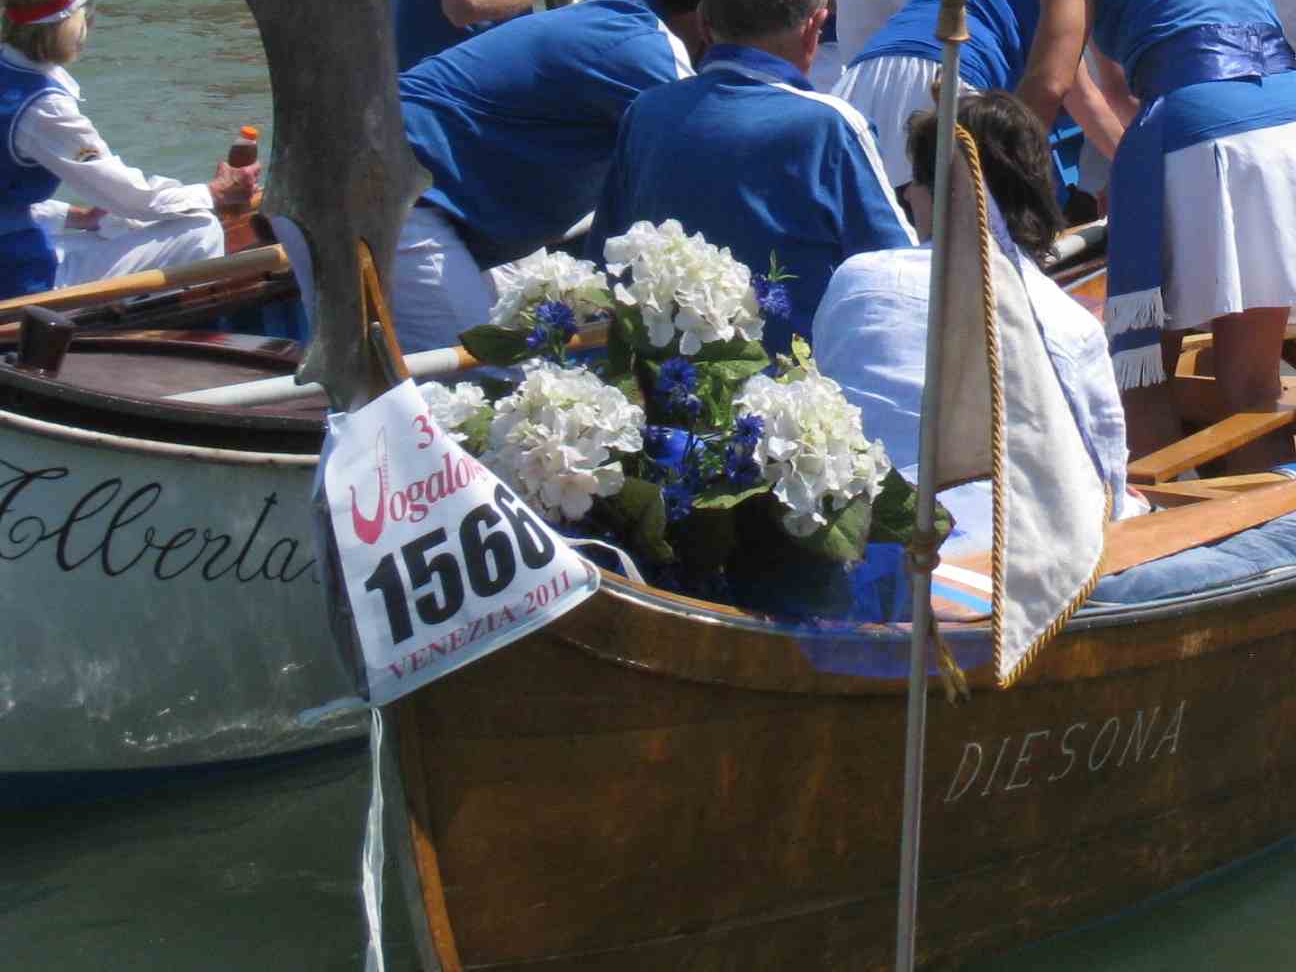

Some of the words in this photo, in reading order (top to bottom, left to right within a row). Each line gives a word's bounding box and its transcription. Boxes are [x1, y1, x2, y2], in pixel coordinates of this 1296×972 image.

[411, 410, 435, 450] 3
[364, 482, 556, 645] 1566
[387, 604, 517, 679] VENEZIA
[525, 570, 572, 616] 2011
[943, 699, 1188, 803] DIESONA
